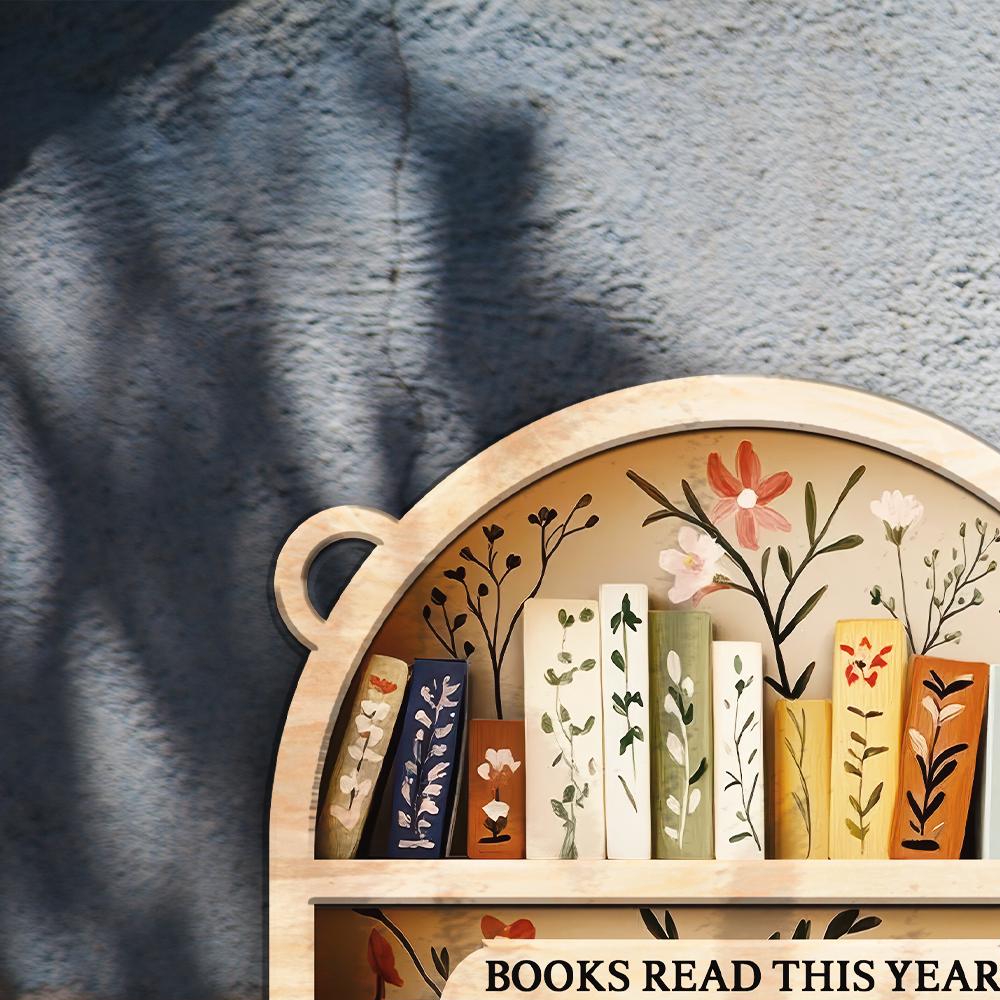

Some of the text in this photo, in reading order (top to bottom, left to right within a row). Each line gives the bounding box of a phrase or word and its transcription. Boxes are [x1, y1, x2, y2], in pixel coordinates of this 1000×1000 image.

[485, 959, 630, 992] BOOKS
[642, 960, 762, 992] READ
[771, 960, 875, 992] THIS
